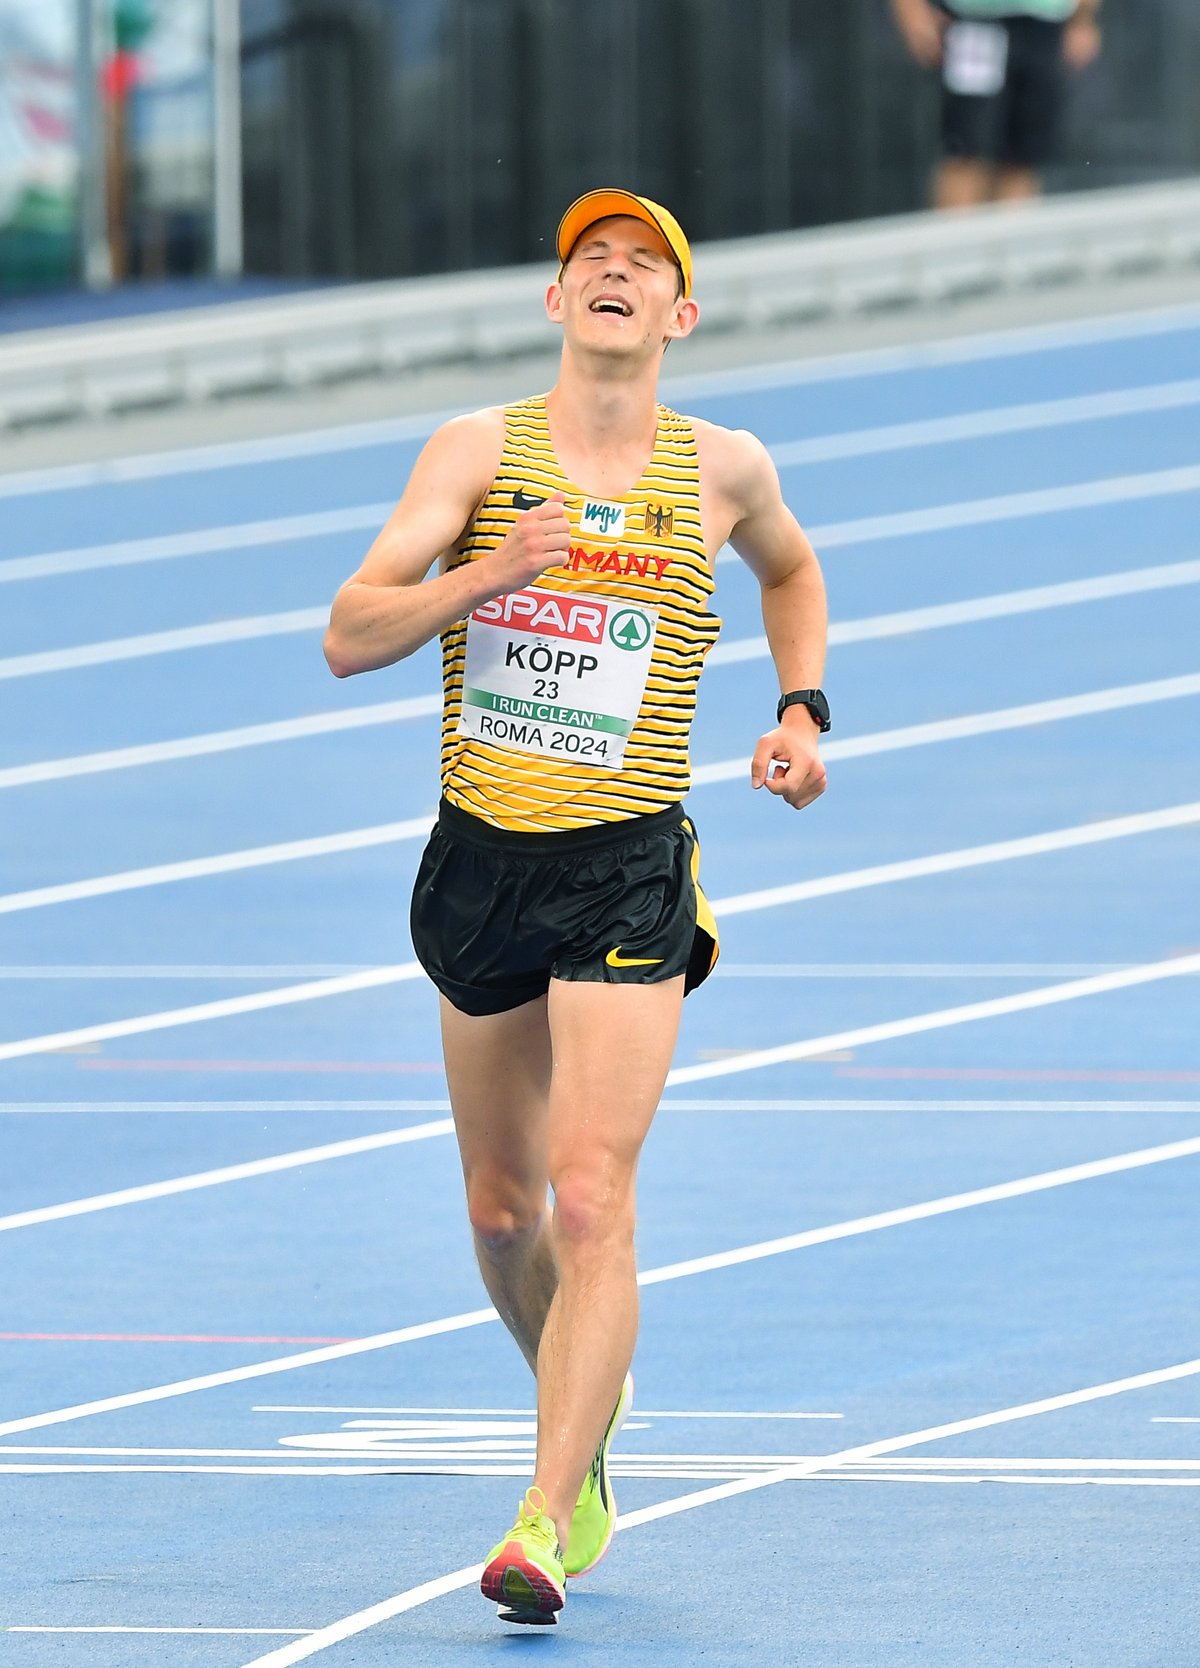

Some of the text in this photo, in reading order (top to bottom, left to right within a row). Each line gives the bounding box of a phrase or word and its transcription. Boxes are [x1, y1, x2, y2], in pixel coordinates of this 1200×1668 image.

[475, 593, 603, 638] SPAR
[505, 642, 598, 679] KÖPP
[492, 696, 497, 709] I
[499, 696, 533, 717] RUN
[532, 679, 559, 700] 23
[480, 716, 608, 758] ROMA 2024
